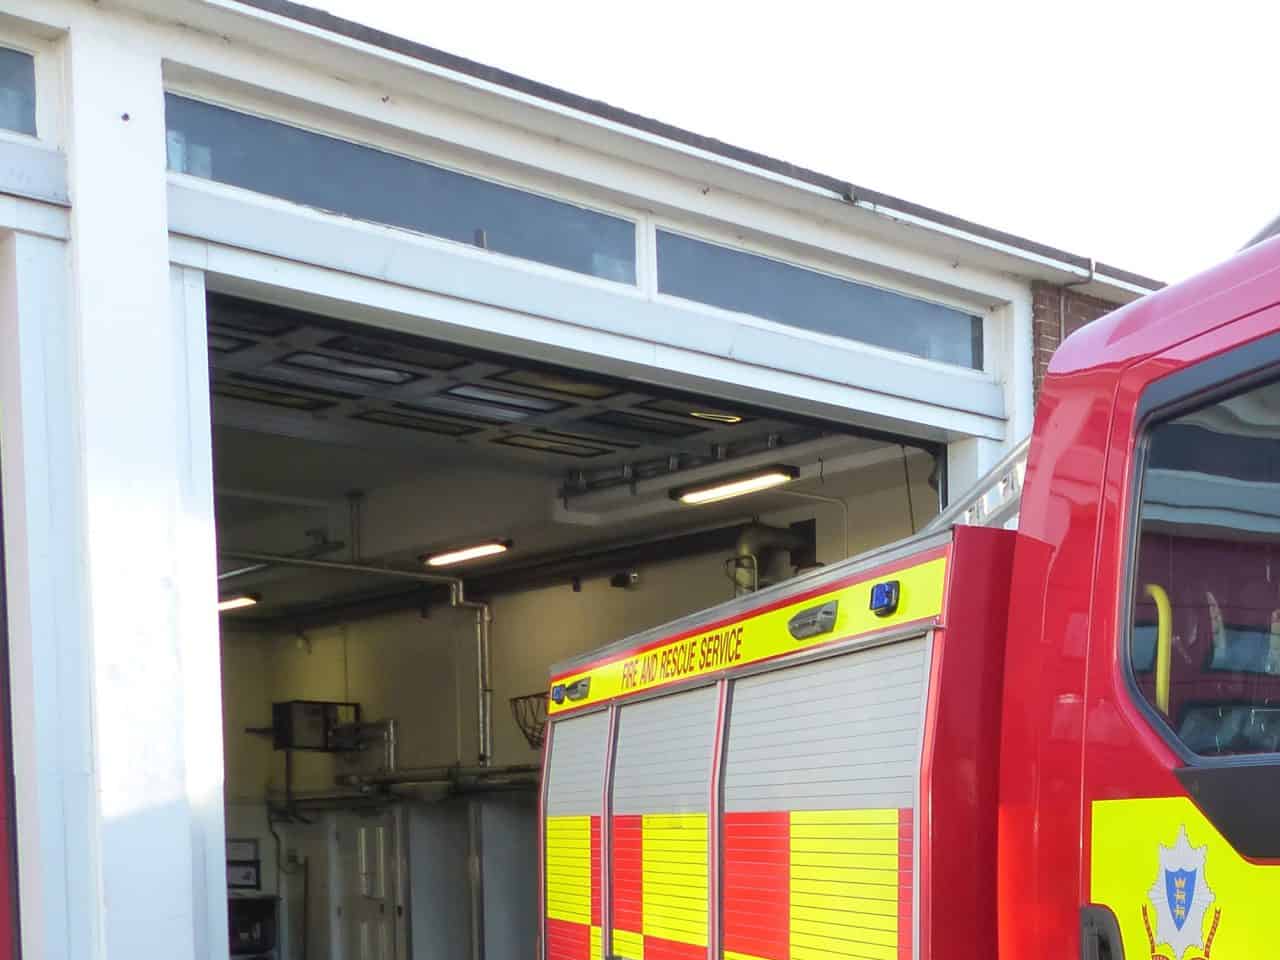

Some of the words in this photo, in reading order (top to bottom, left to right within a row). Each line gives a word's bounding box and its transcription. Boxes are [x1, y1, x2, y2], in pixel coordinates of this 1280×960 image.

[621, 658, 639, 689] FIRE
[640, 653, 658, 683] AND
[660, 641, 697, 681] RESCUE
[699, 627, 743, 670] SERVICE
